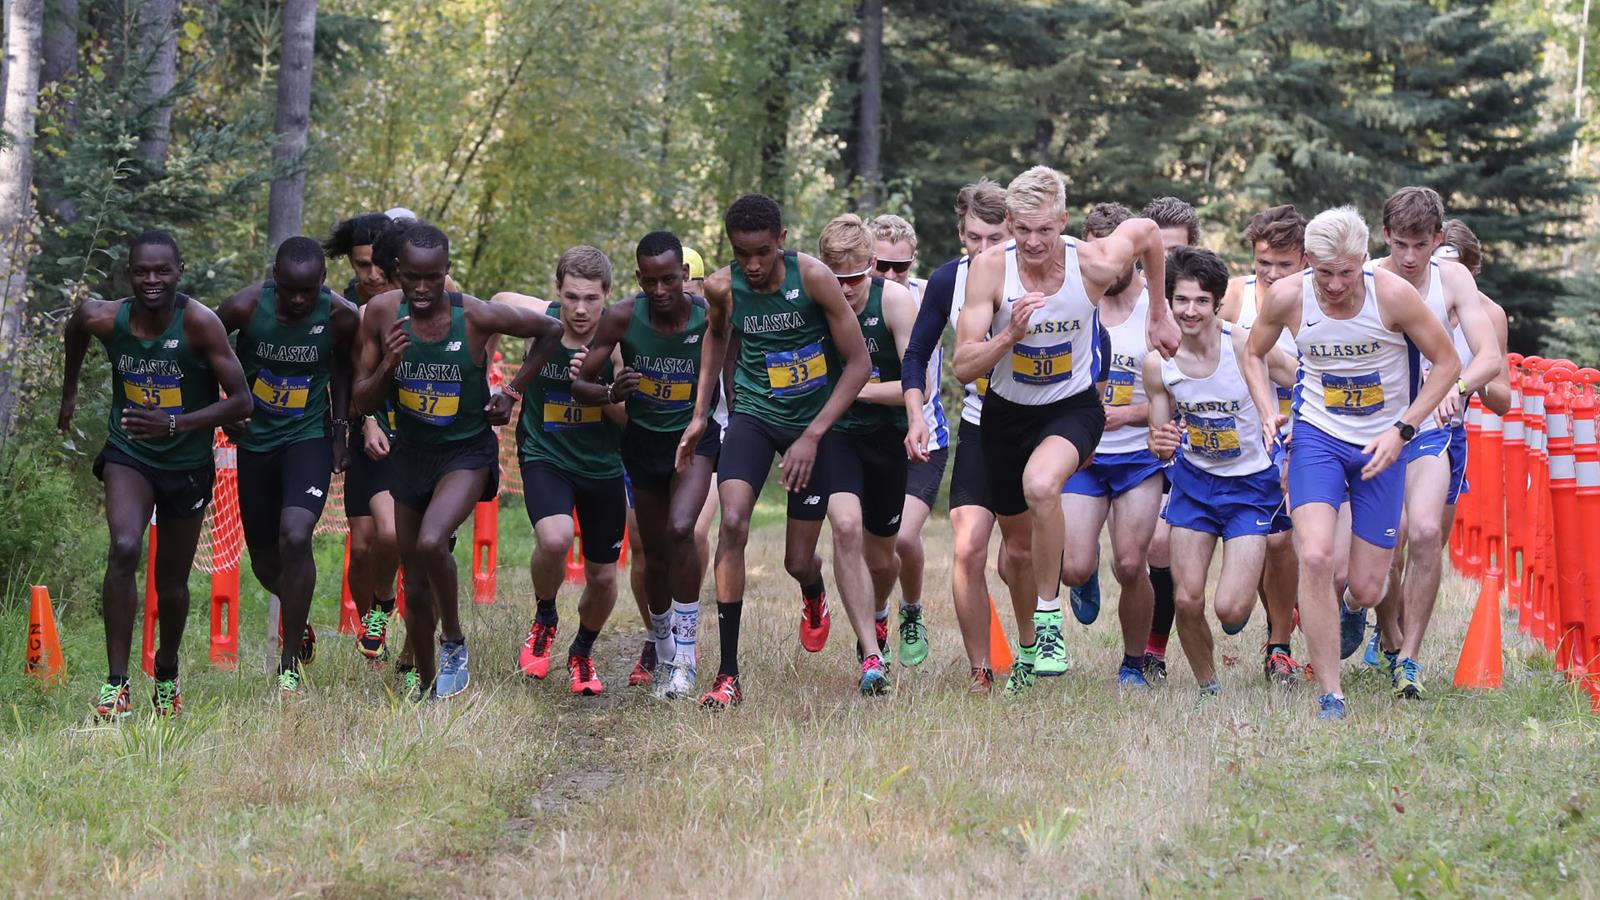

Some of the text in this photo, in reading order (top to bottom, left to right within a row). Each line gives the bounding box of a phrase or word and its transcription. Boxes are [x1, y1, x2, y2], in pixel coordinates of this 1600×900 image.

[744, 311, 806, 334] ALASKA
[1027, 320, 1081, 335] ASKA
[256, 342, 319, 363] ALASKA
[1310, 341, 1382, 357] ALASKA
[118, 354, 183, 376] ALASKA
[394, 361, 463, 382] ALASKA
[540, 362, 570, 380] ALA
[632, 354, 695, 375] ALASKA
[789, 363, 809, 384] 33
[1033, 359, 1053, 376] 30
[141, 388, 161, 406] 35
[269, 390, 290, 406] 34
[652, 383, 672, 399] 36
[1104, 385, 1114, 403] 9
[1343, 390, 1362, 407] 27
[418, 395, 438, 413] 37
[1177, 401, 1240, 413] ALASKA
[564, 407, 582, 422] 40
[1201, 431, 1220, 449] 26
